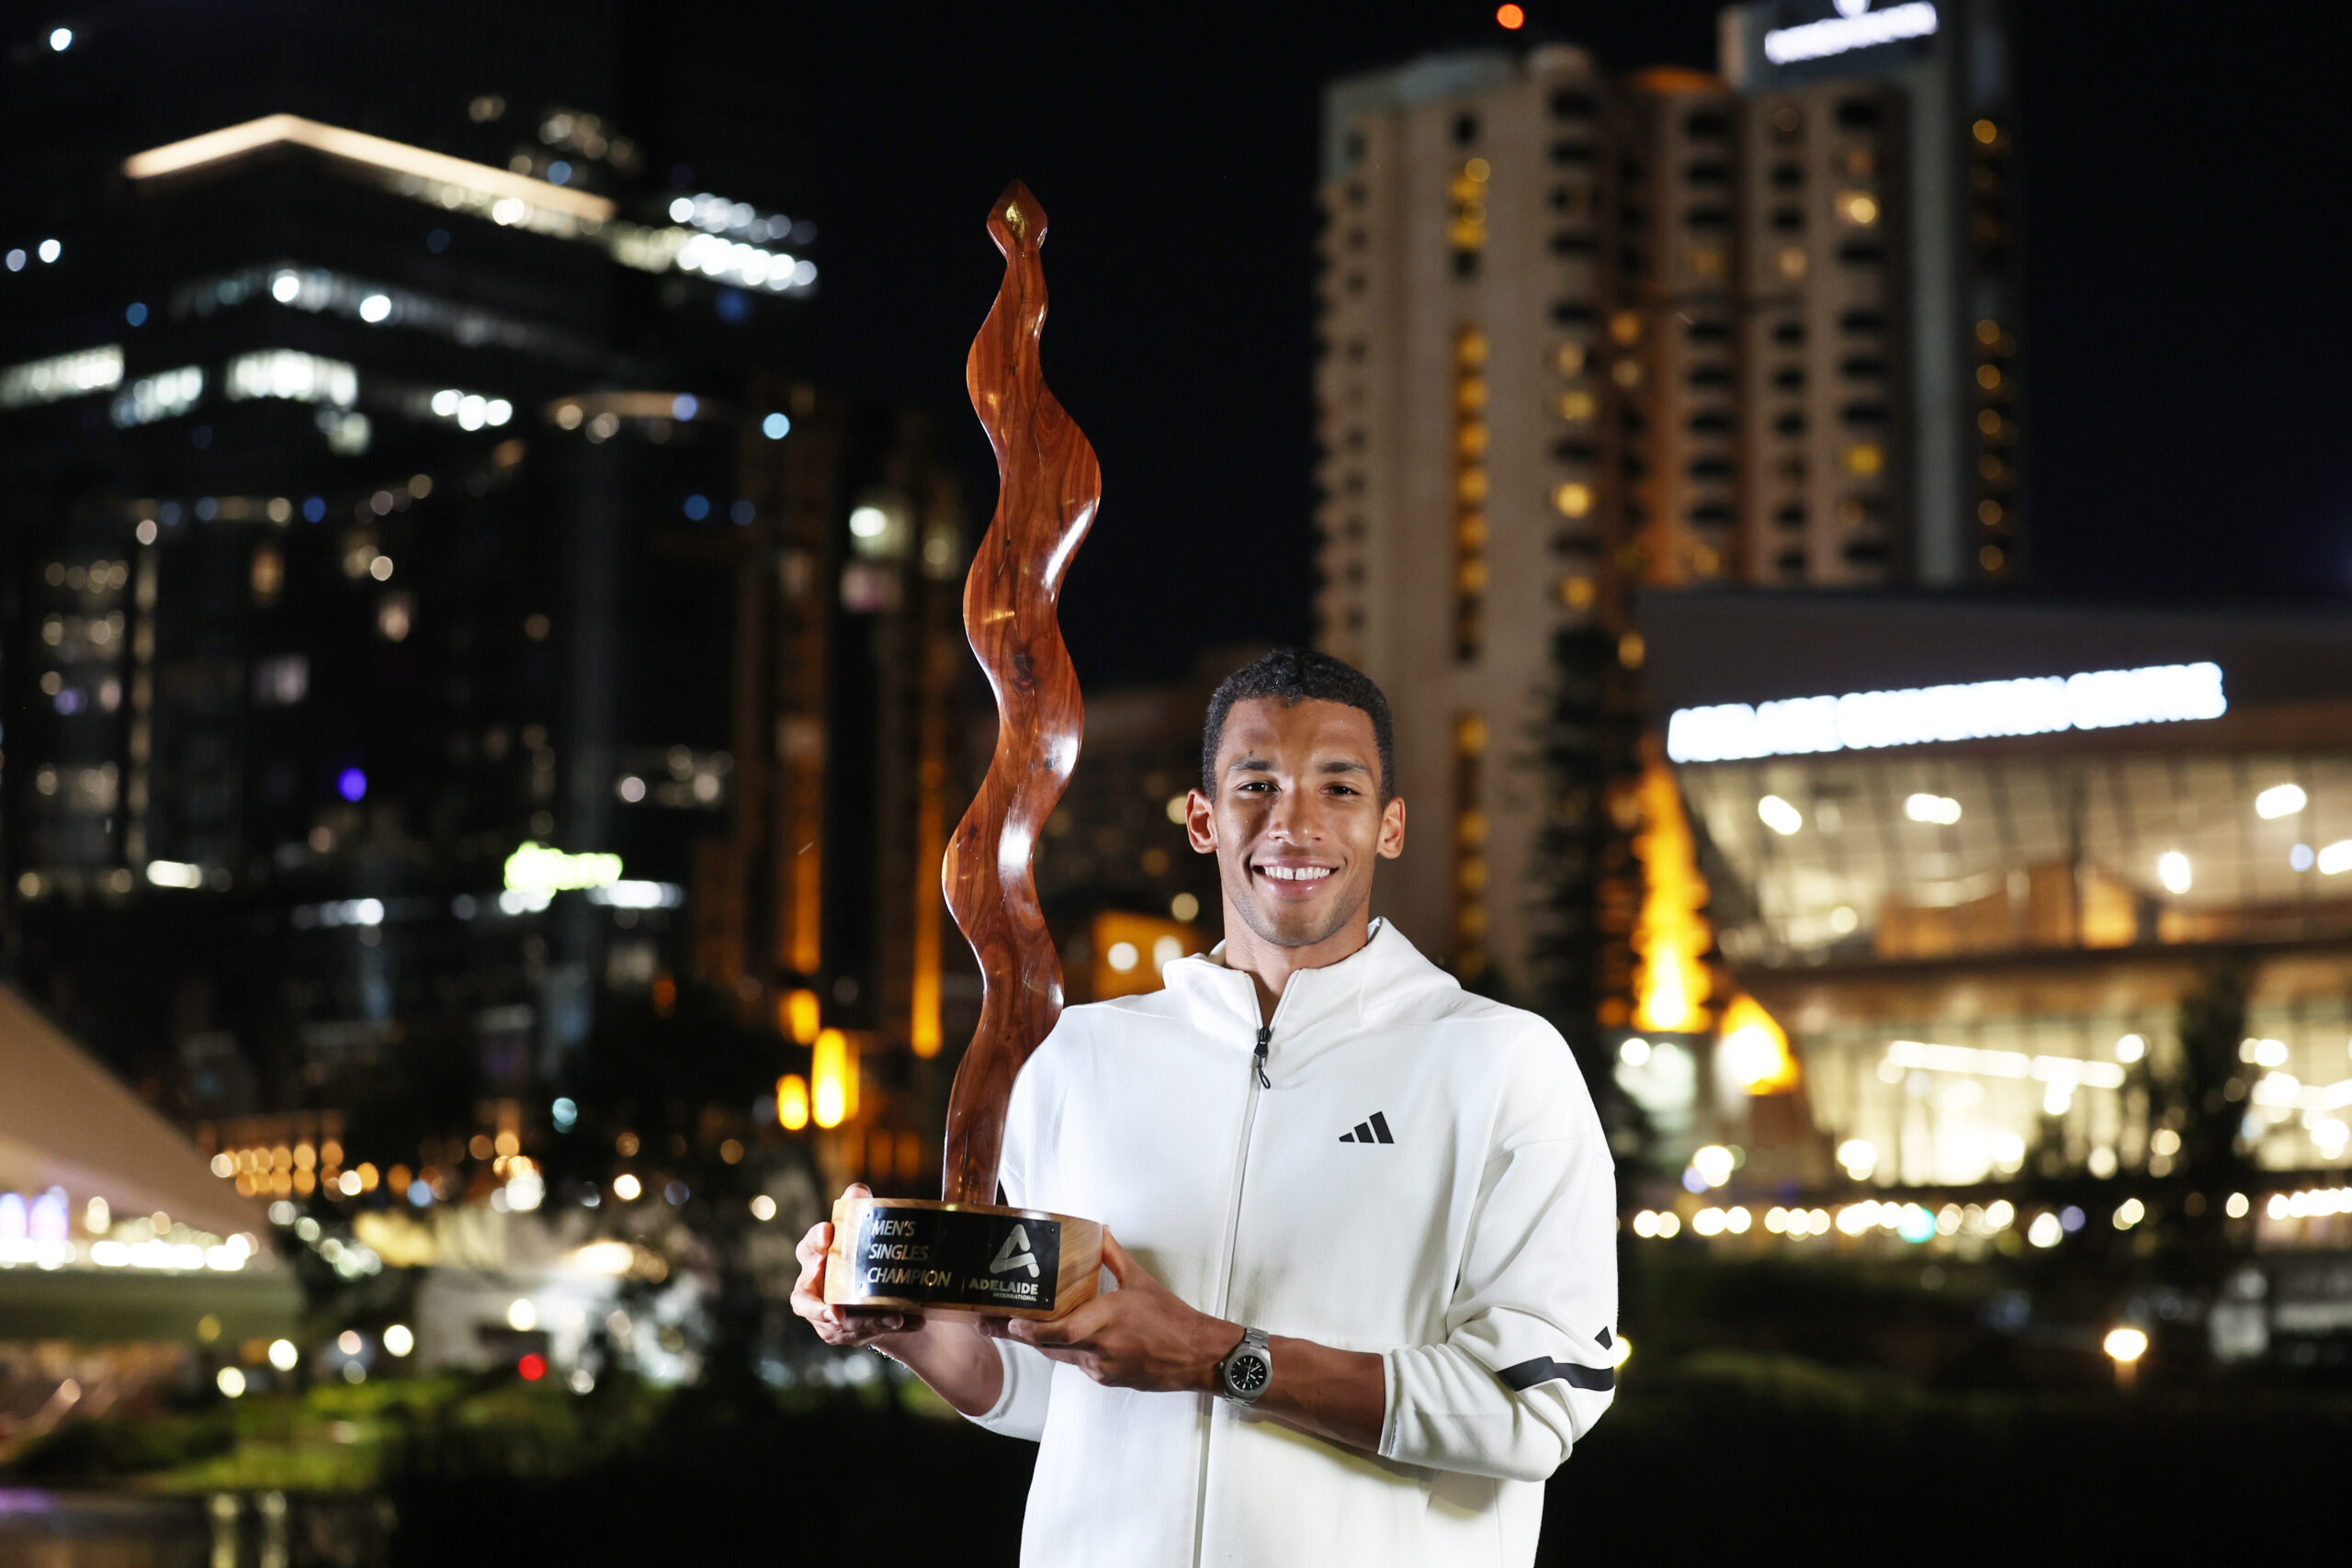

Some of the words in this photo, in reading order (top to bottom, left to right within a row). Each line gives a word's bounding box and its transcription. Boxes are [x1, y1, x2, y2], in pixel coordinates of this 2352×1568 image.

[871, 1219, 916, 1236] MEN'S
[868, 1243, 929, 1261] SINGLES
[866, 1267, 952, 1287] CHAMPION
[969, 1278, 1039, 1295] ADELAIDE
[992, 1292, 1037, 1302] INTERNATIONAL
